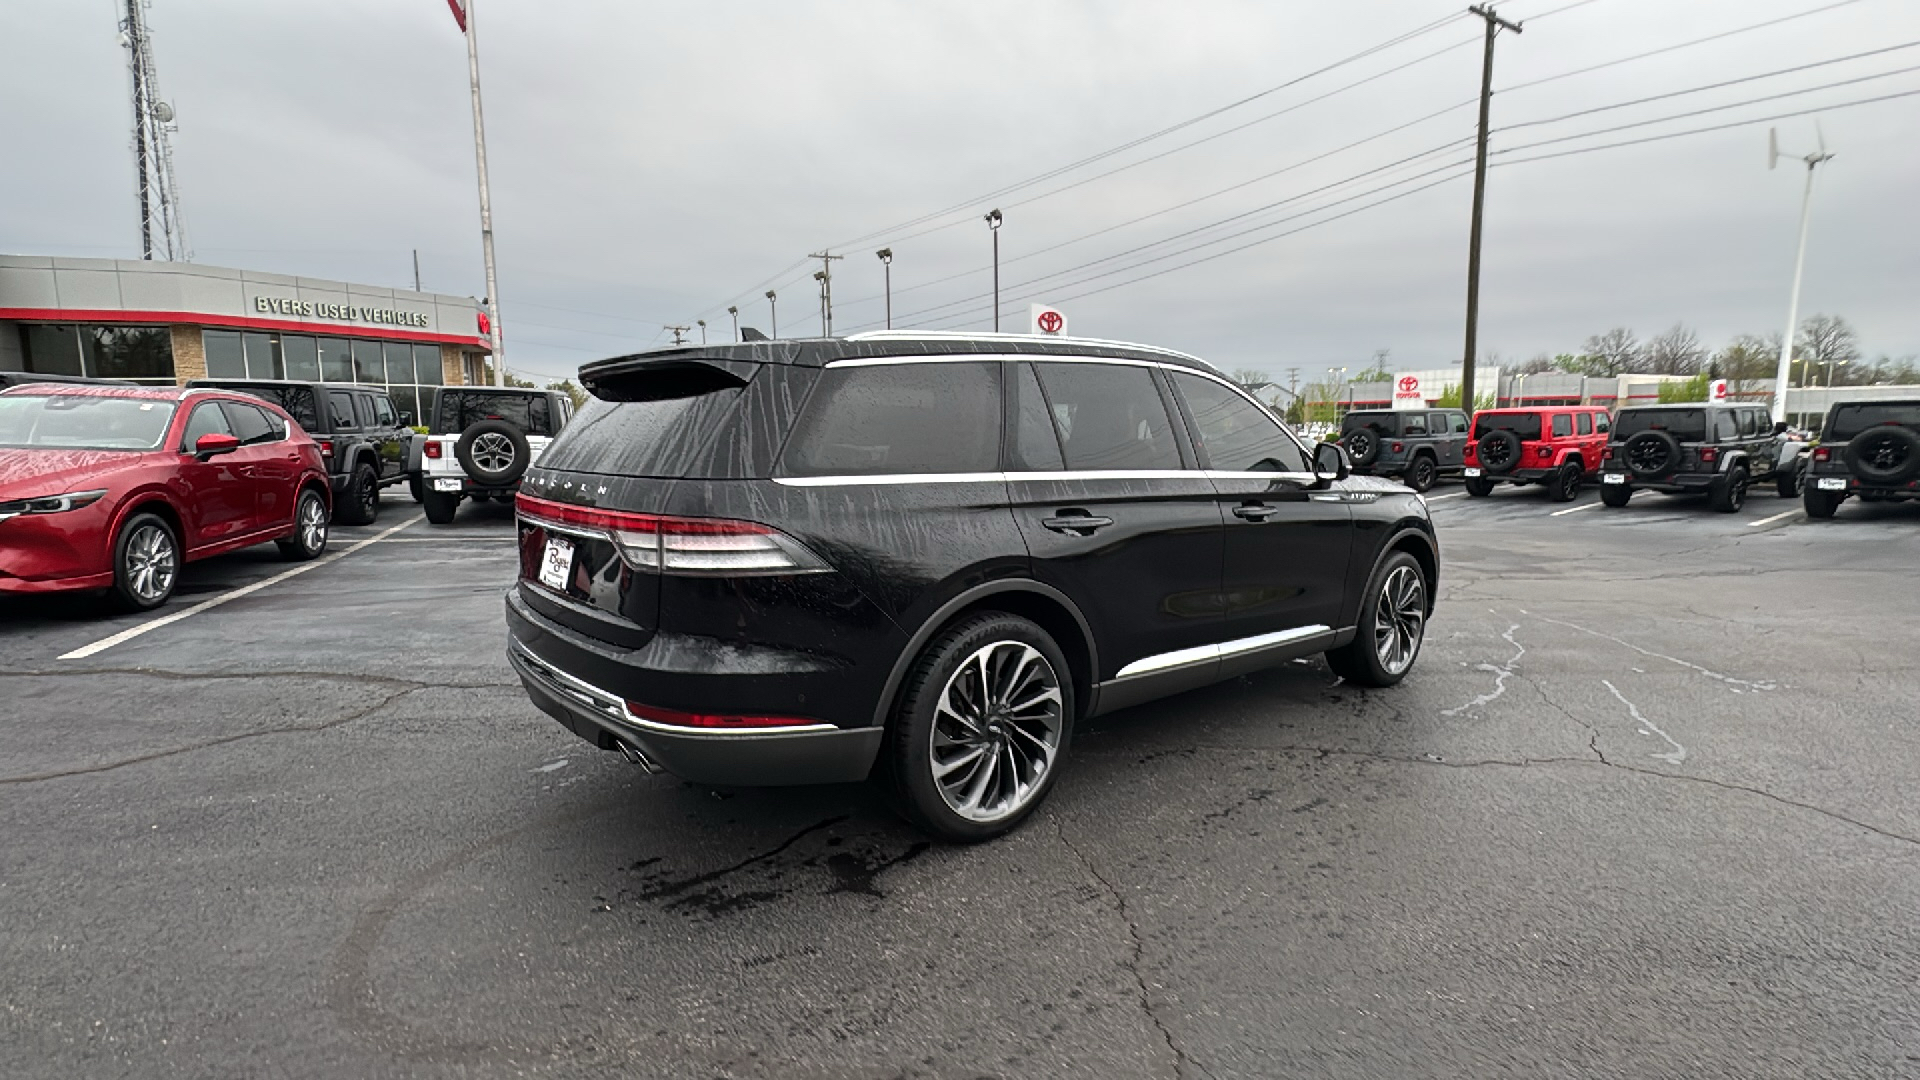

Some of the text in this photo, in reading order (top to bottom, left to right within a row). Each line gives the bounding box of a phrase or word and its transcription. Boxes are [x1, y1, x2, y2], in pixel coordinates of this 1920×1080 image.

[256, 296, 429, 327] BYERS USED VEHICLES
